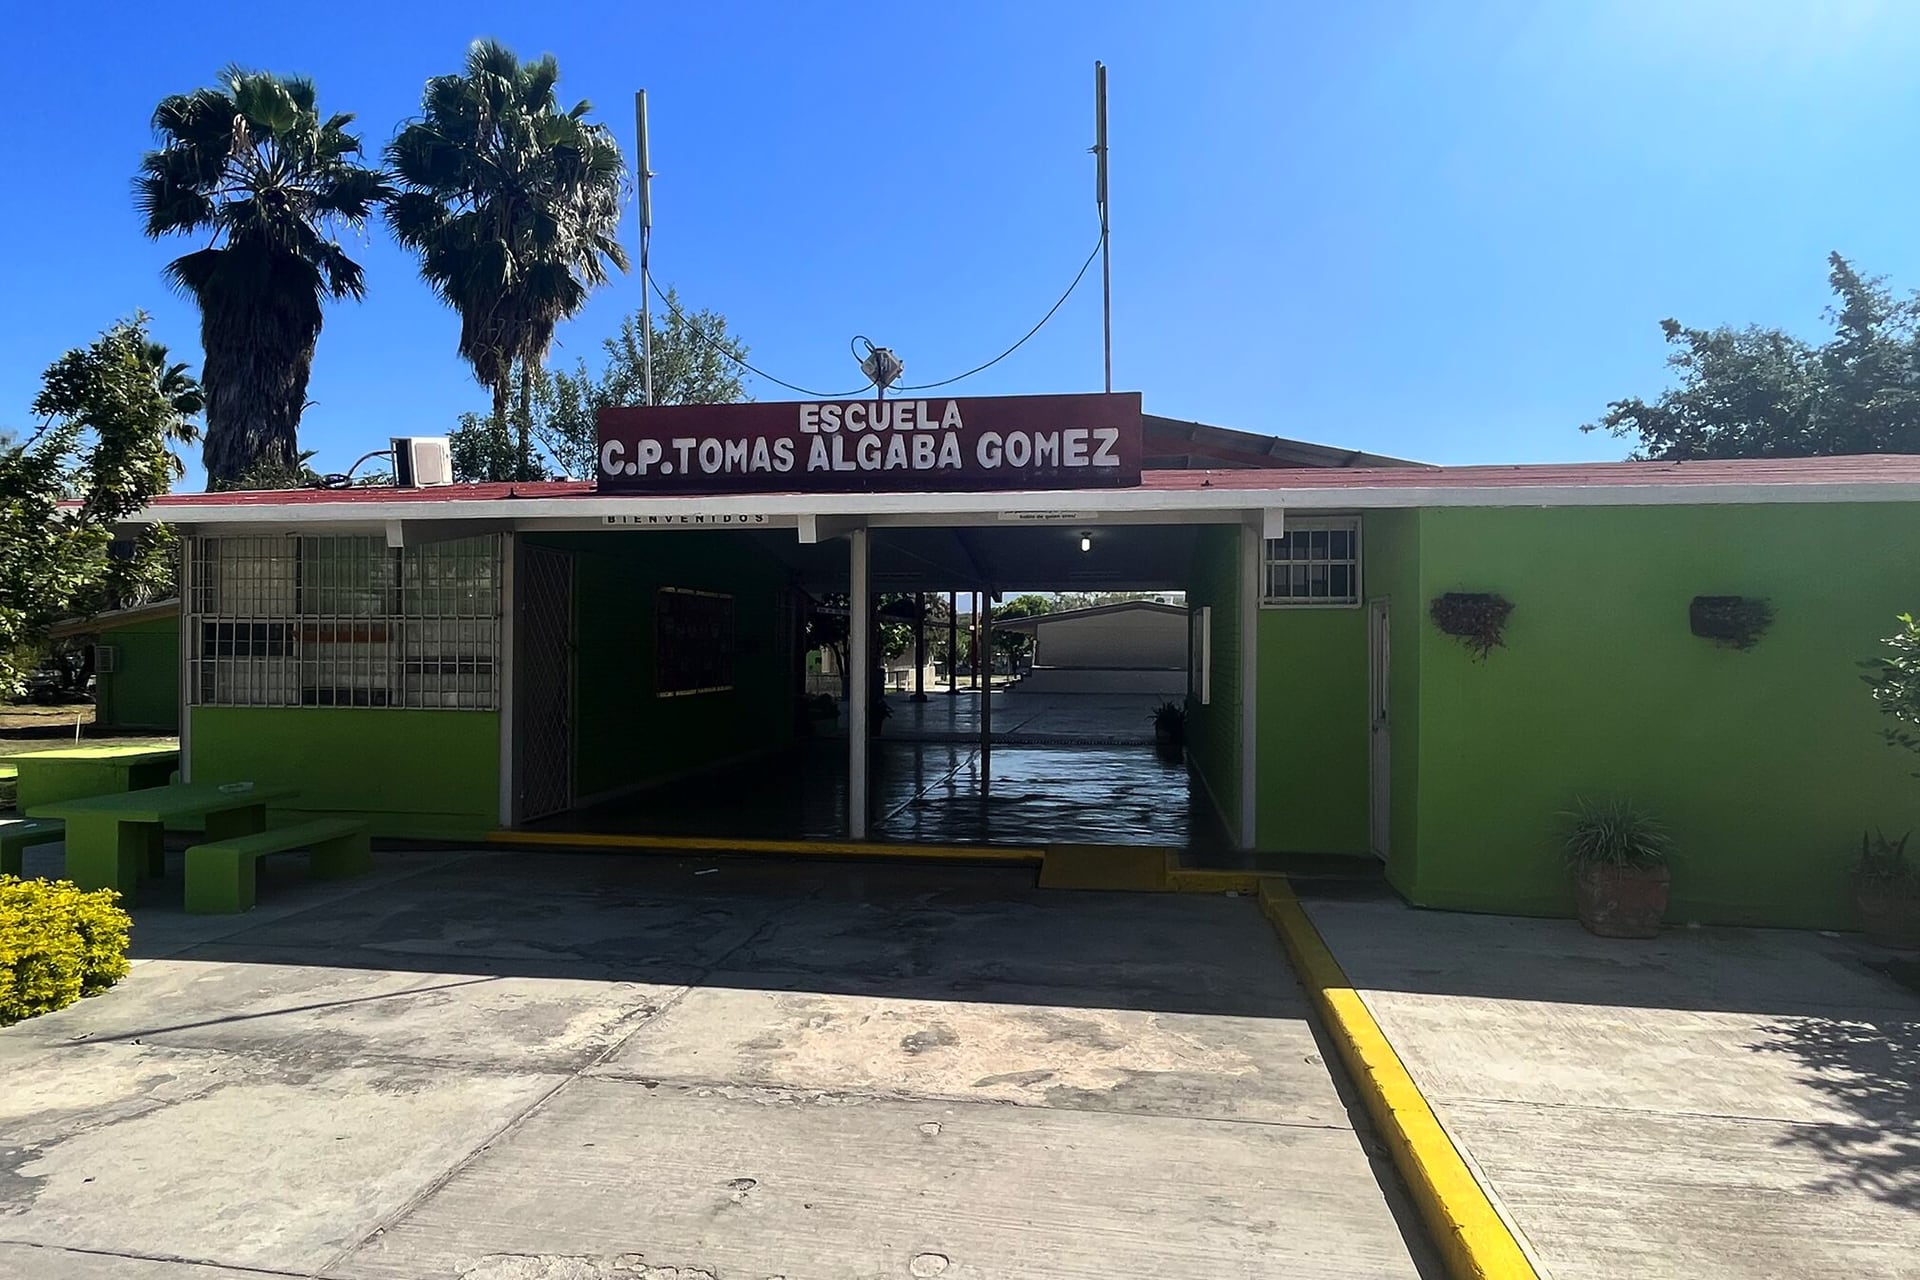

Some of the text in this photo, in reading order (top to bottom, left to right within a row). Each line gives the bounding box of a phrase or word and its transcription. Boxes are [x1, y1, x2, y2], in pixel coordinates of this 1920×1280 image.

[799, 400, 963, 434] ESCUELA
[806, 431, 963, 473] ALGABA
[975, 427, 1121, 469] GOMEZ
[607, 514, 764, 524] BIENVENIDOS
